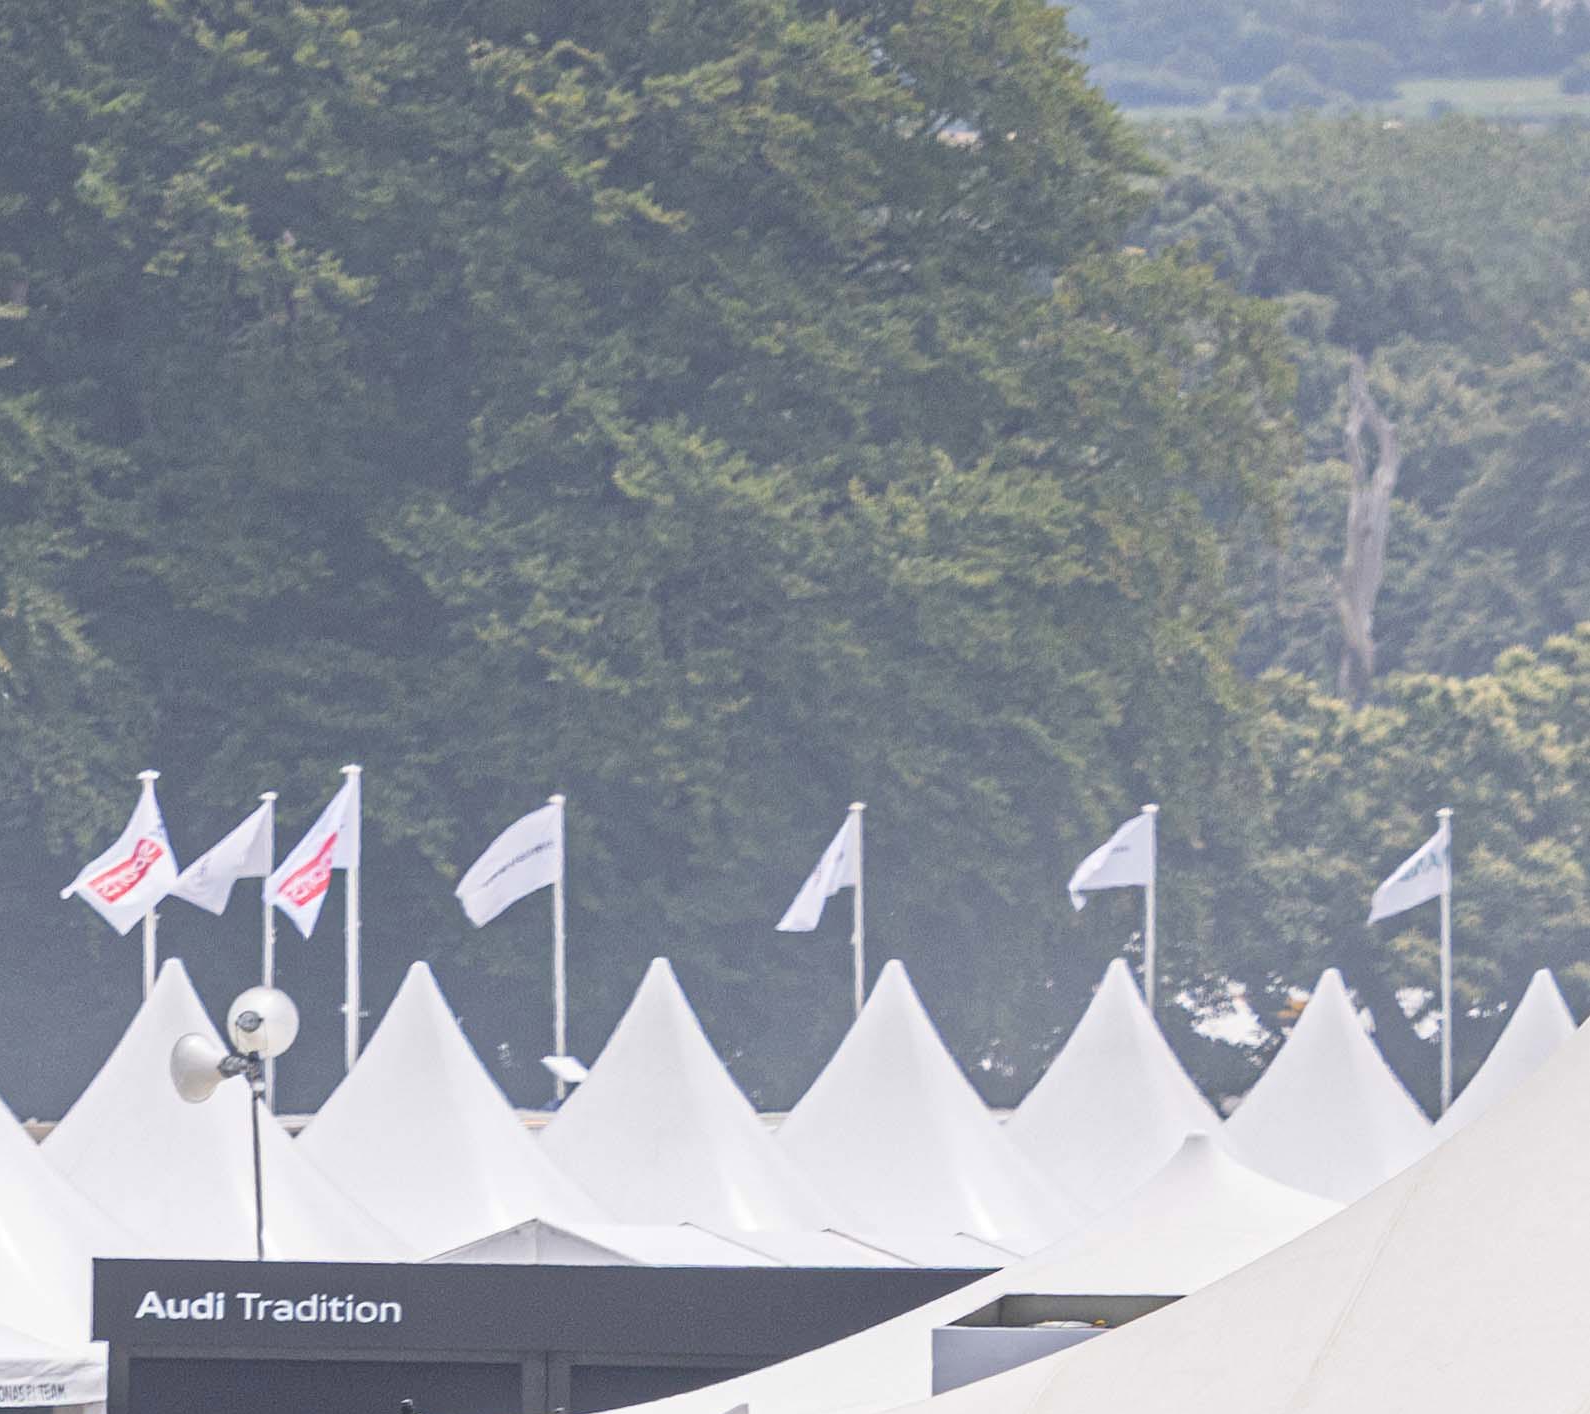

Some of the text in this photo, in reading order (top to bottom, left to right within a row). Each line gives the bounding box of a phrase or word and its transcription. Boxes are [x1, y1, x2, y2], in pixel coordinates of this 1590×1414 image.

[134, 1291, 402, 1323] Audi Tradition
[36, 1384, 66, 1401] TEAM
